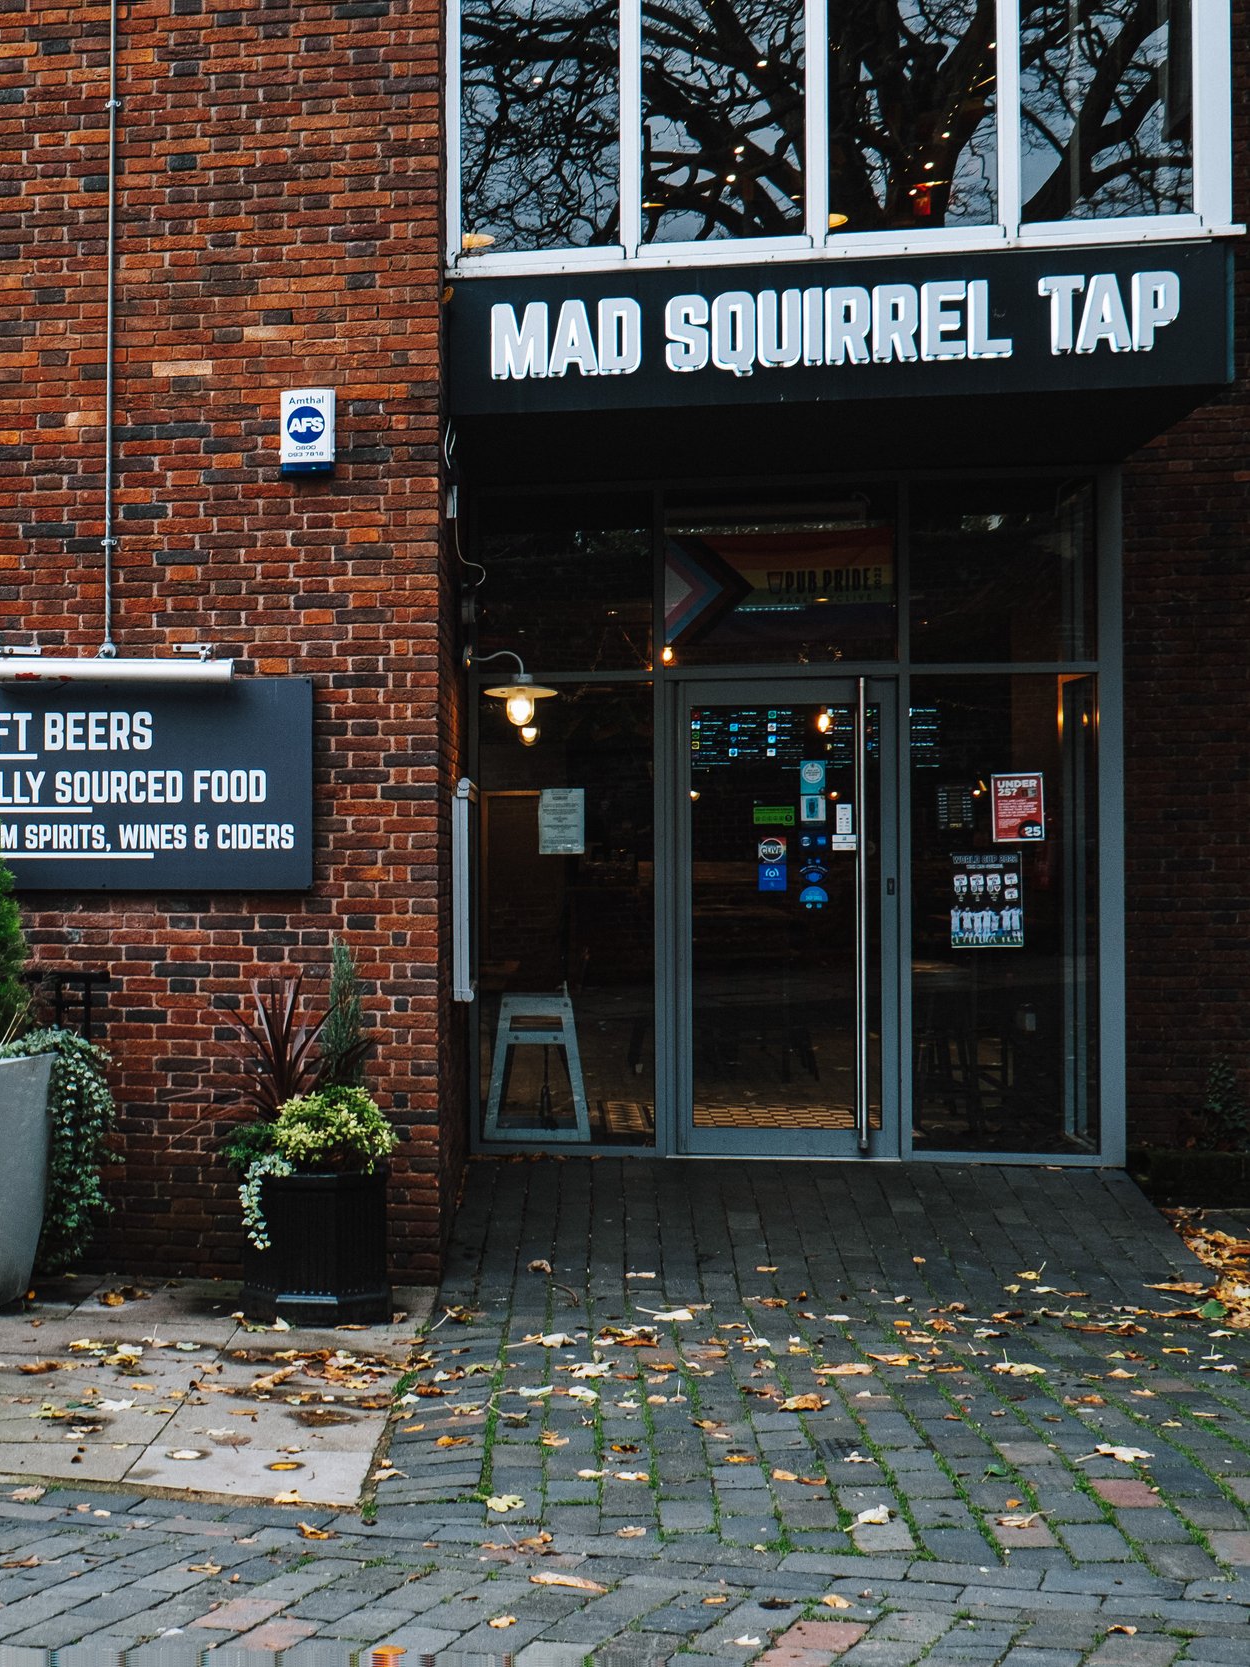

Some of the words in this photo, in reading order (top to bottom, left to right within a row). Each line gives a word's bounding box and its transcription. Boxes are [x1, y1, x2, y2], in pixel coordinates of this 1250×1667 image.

[490, 298, 641, 380] MAD
[665, 279, 1014, 377] SQUIRREL
[1037, 271, 1180, 357] TAP
[289, 396, 324, 405] Amthal
[289, 417, 323, 433] AFS
[785, 570, 817, 593] PUB
[823, 567, 871, 593] PRIDE
[43, 711, 153, 752] BEERS
[54, 769, 184, 804] SOURCED
[193, 769, 268, 804] FOOD
[997, 779, 1037, 788] UNDER
[997, 788, 1018, 797] 25?
[24, 823, 112, 853] SPIRITS,
[118, 823, 187, 851] WINES
[194, 823, 209, 850] &
[216, 823, 295, 851] CIDERS
[1024, 826, 1042, 837] 25
[761, 845, 782, 854] CLIVE
[953, 855, 980, 864] WORLD
[981, 854, 998, 863] CUP
